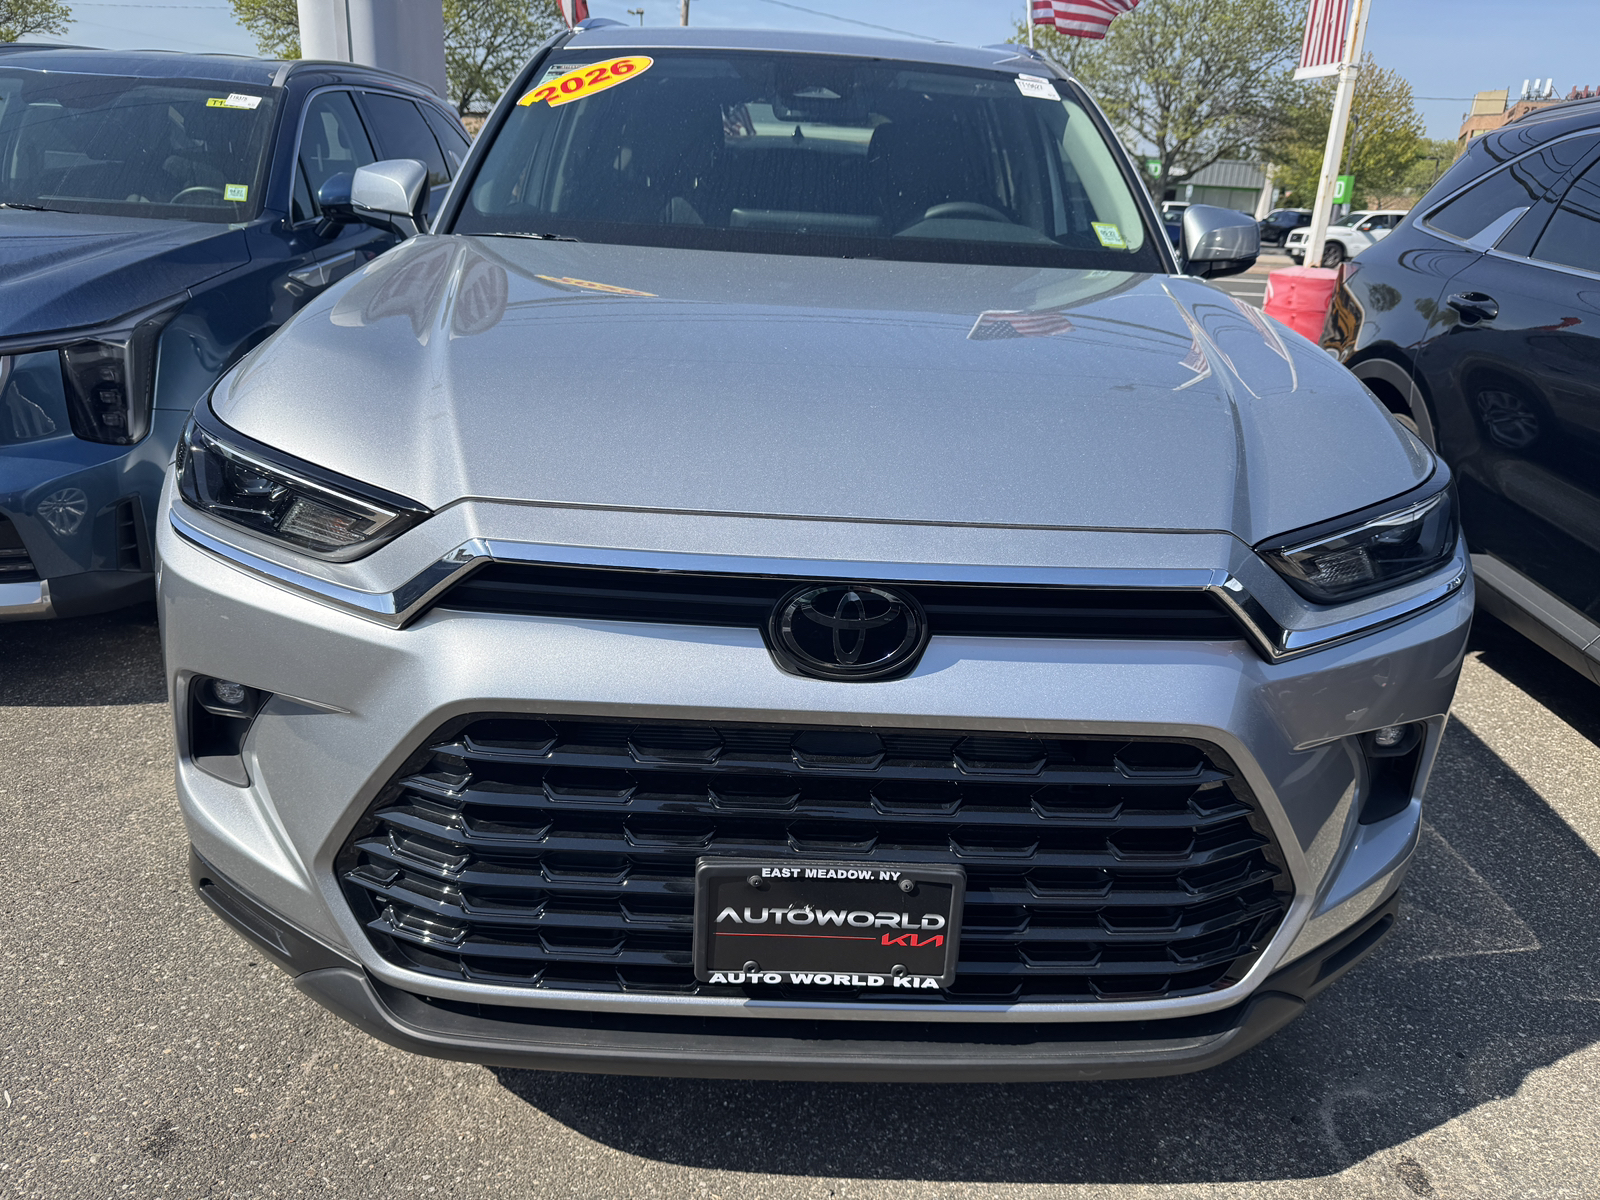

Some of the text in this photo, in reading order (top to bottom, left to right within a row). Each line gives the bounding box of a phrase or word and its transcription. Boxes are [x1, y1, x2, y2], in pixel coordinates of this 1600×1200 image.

[534, 60, 636, 102] 2026
[761, 868, 800, 878] EAST
[879, 873, 901, 881] NY
[714, 906, 945, 929] AUTOWORLD
[881, 933, 943, 947] KIA
[709, 973, 939, 989] AUTO WORLD KIA
